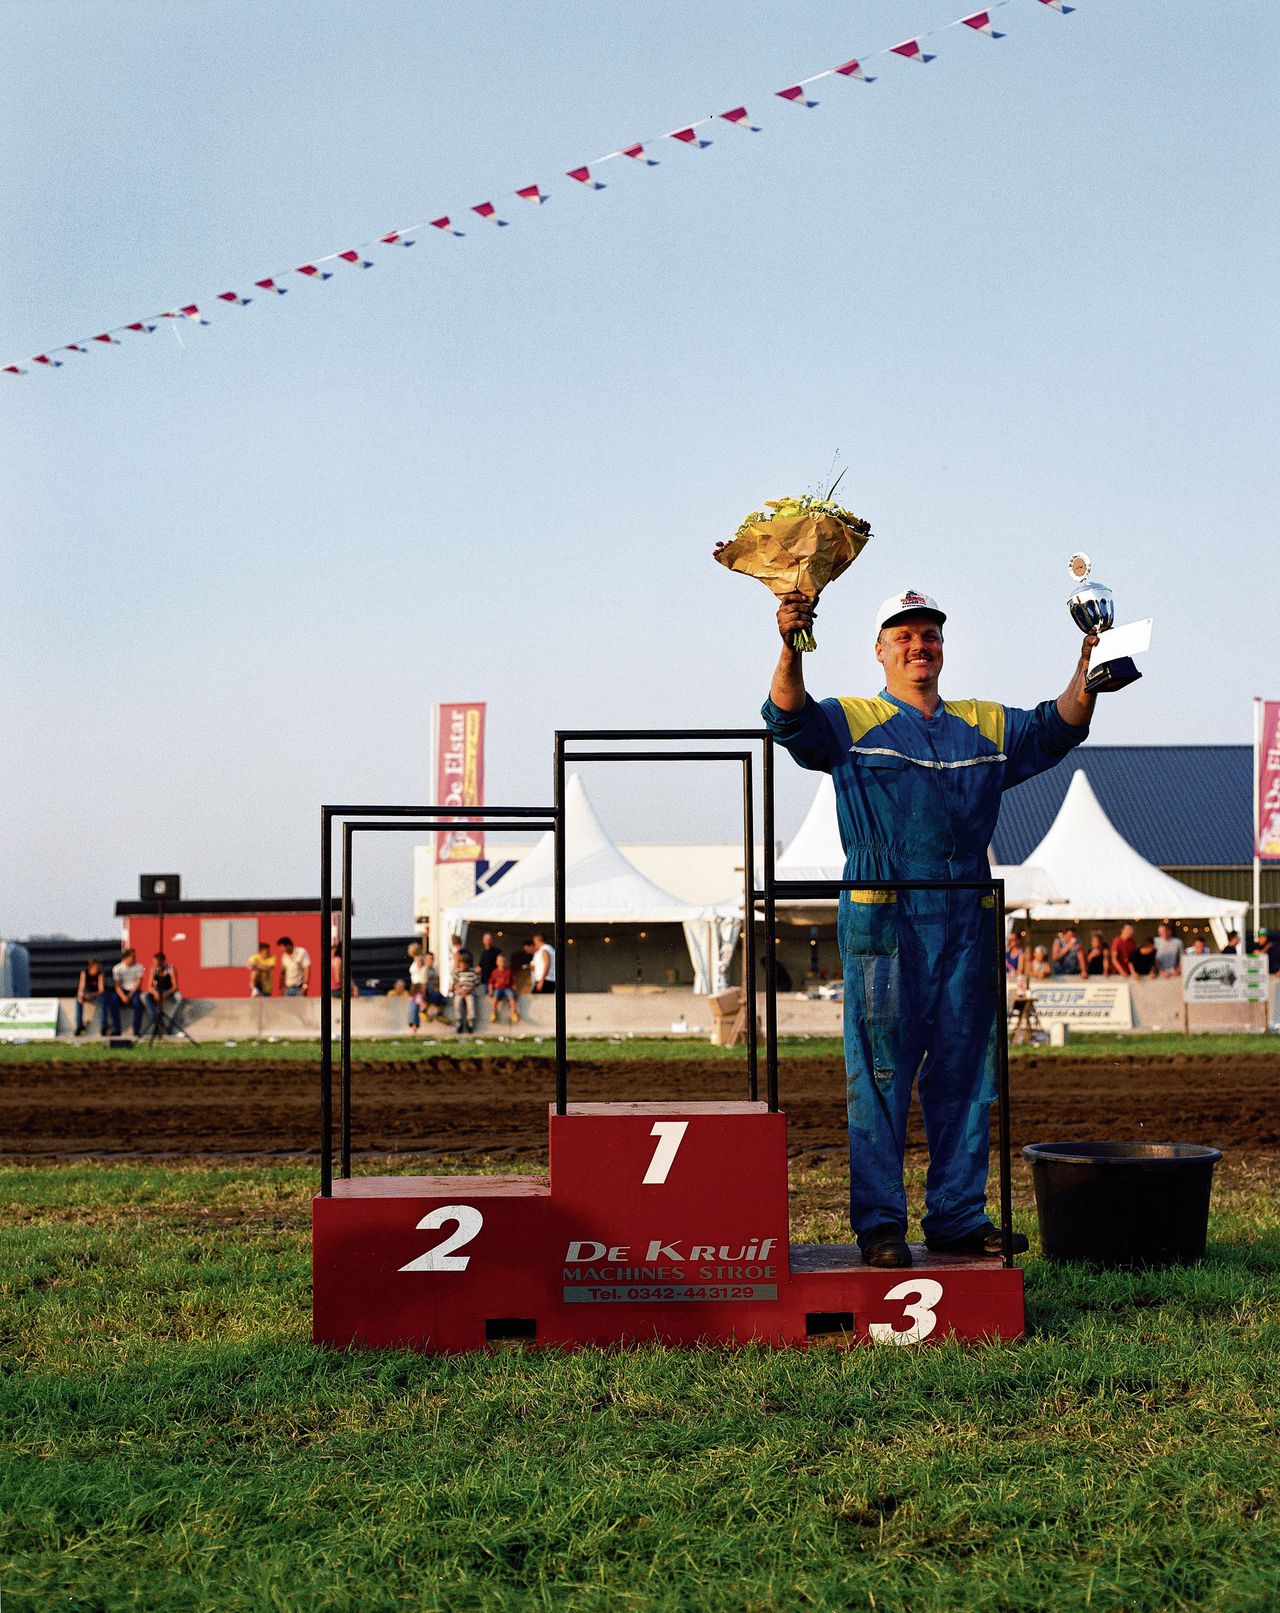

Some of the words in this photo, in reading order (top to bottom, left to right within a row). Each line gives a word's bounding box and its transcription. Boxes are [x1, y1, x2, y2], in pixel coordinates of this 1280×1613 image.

[444, 709, 465, 775] Elstar
[642, 1121, 689, 1184] 1
[397, 1205, 484, 1271] 2
[562, 1267, 686, 1281] MACHINES
[699, 1265, 777, 1279] STROE
[587, 1288, 622, 1300] Tel.
[627, 1287, 755, 1300] 0342-443129
[869, 1278, 943, 1346] 3
